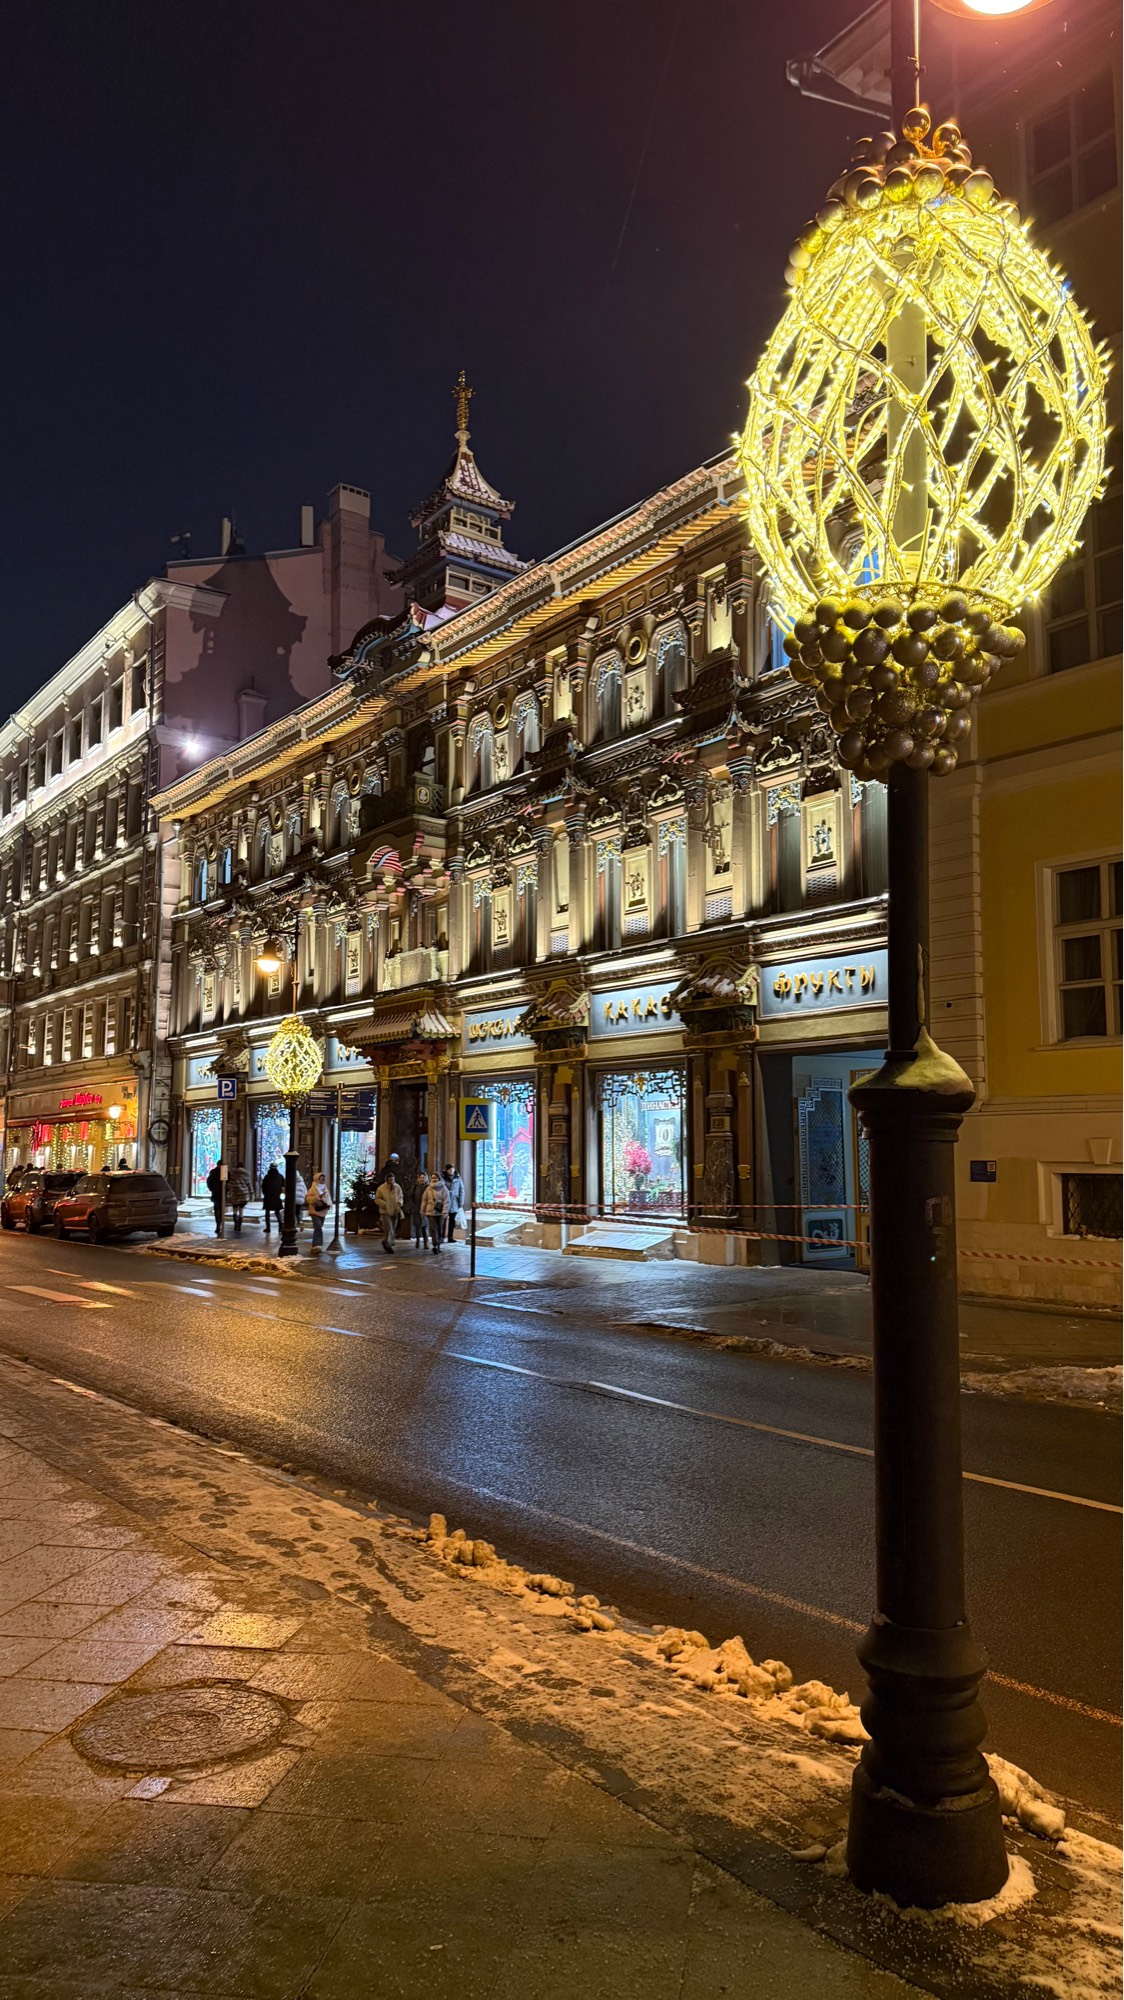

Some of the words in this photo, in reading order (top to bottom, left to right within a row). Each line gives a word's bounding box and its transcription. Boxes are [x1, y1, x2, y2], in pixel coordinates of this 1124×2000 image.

[773, 965, 875, 995] ФРУКТЫ
[603, 994, 670, 1019] КАКАО
[468, 1015, 525, 1039] ШОКОЛА
